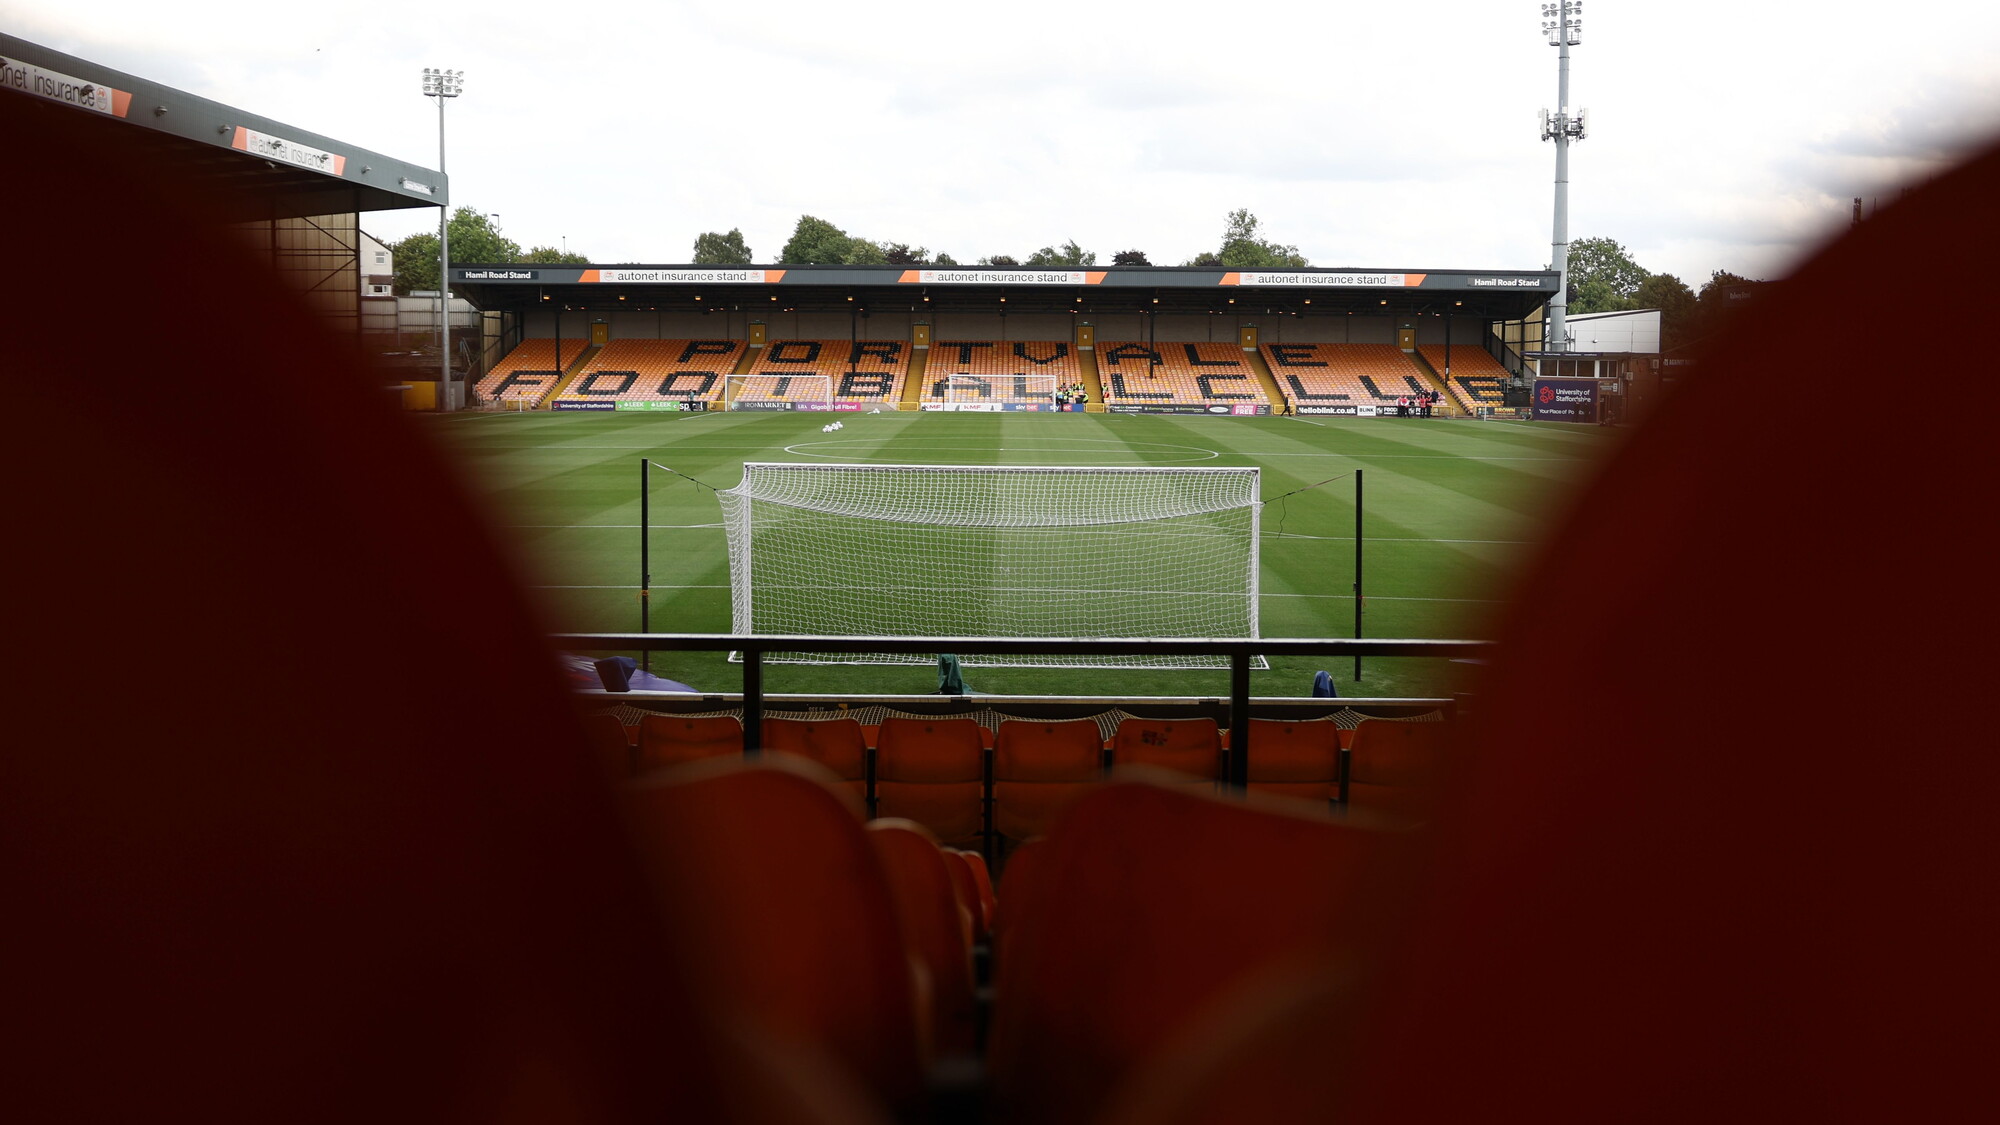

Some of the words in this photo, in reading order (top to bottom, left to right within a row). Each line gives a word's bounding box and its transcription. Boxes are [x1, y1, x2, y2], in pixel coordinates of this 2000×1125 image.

[465, 271, 488, 279] Hamil
[489, 271, 508, 279] Road
[509, 271, 531, 279] Stand
[617, 271, 658, 281] autonet
[661, 271, 714, 281] insurance
[716, 271, 747, 281] stand
[937, 272, 978, 282] autonet
[981, 272, 1034, 282] insurance
[1037, 272, 1068, 282] stand
[1258, 274, 1299, 284] autonet
[1302, 274, 1354, 284] insurance
[1356, 274, 1387, 284] stand
[1474, 278, 1497, 286] Hamil
[1497, 278, 1518, 287] Road
[1518, 278, 1540, 287] Stand
[1555, 388, 1583, 397] University
[1583, 388, 1591, 396] of
[1555, 395, 1591, 403] Staffordshire
